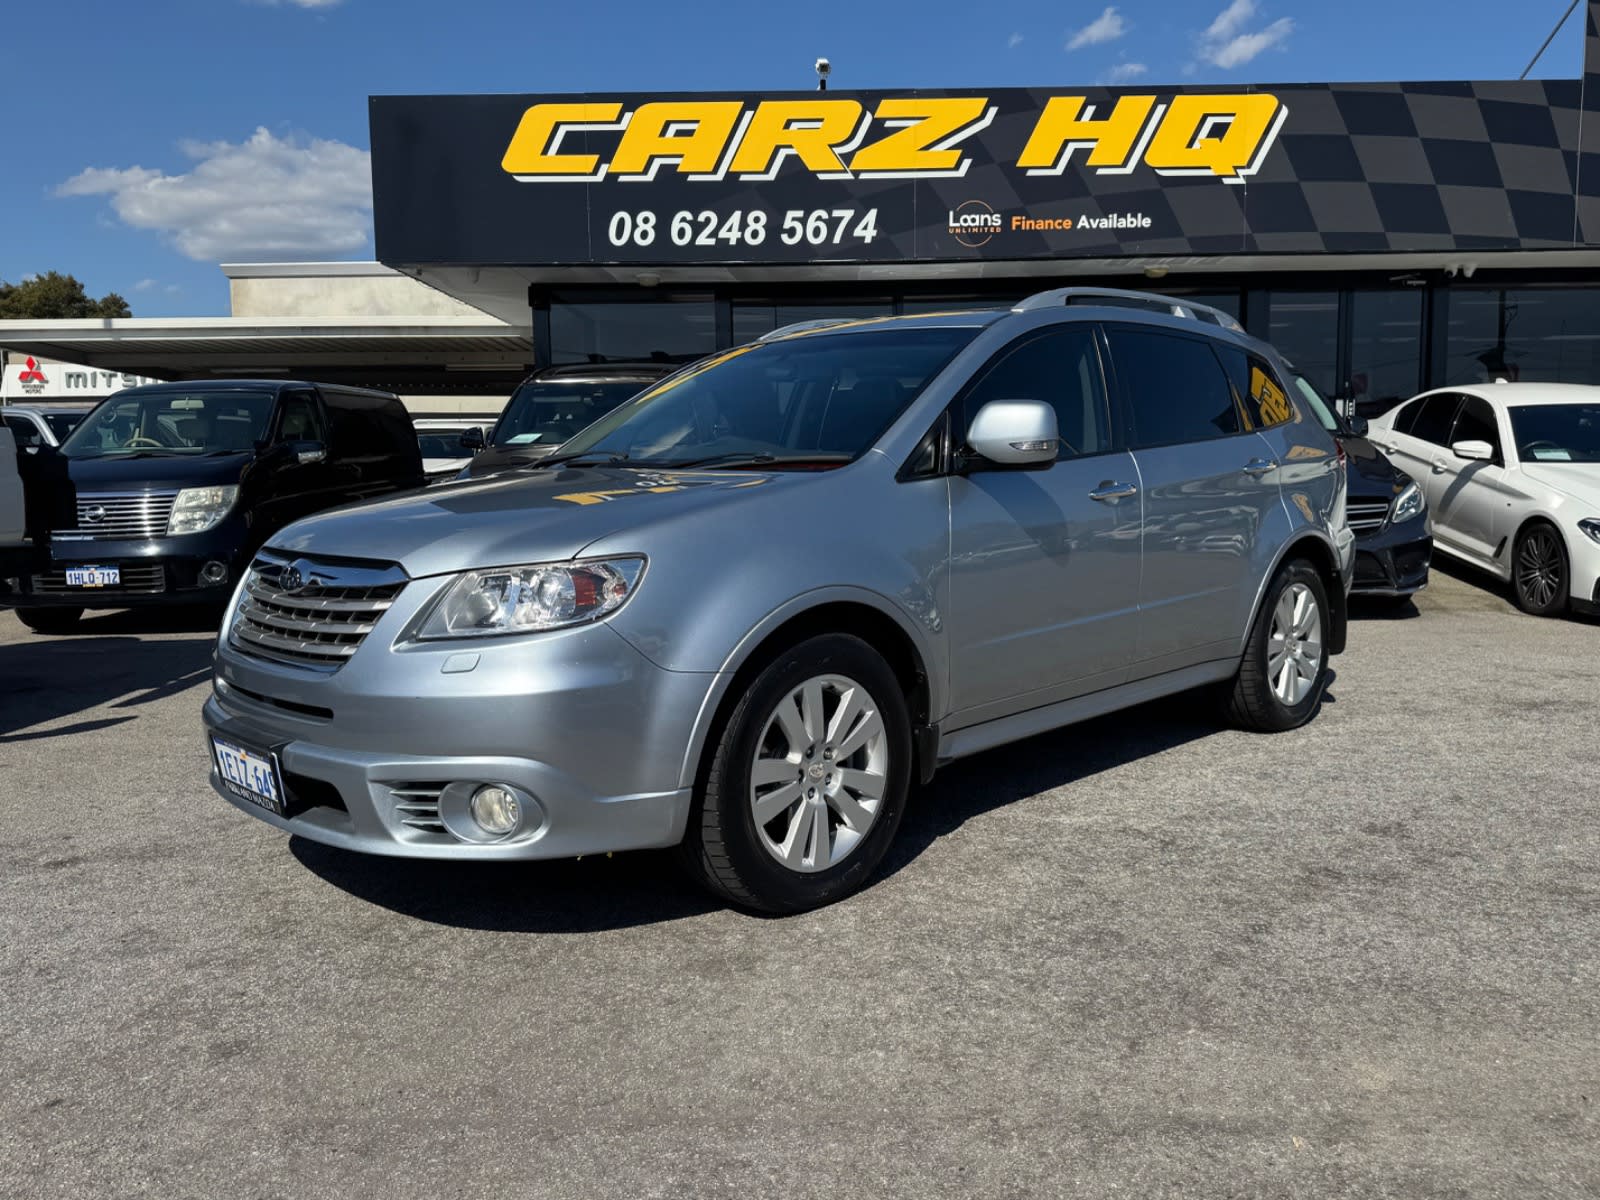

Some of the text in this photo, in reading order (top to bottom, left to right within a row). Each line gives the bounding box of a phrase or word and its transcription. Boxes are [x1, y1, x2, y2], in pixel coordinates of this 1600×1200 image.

[501, 94, 1288, 184] CARZ HQ
[608, 208, 878, 246] 08 6248 5674
[949, 210, 1002, 227] Loans
[1011, 213, 1152, 231] Finance Available
[64, 371, 160, 389] MITS
